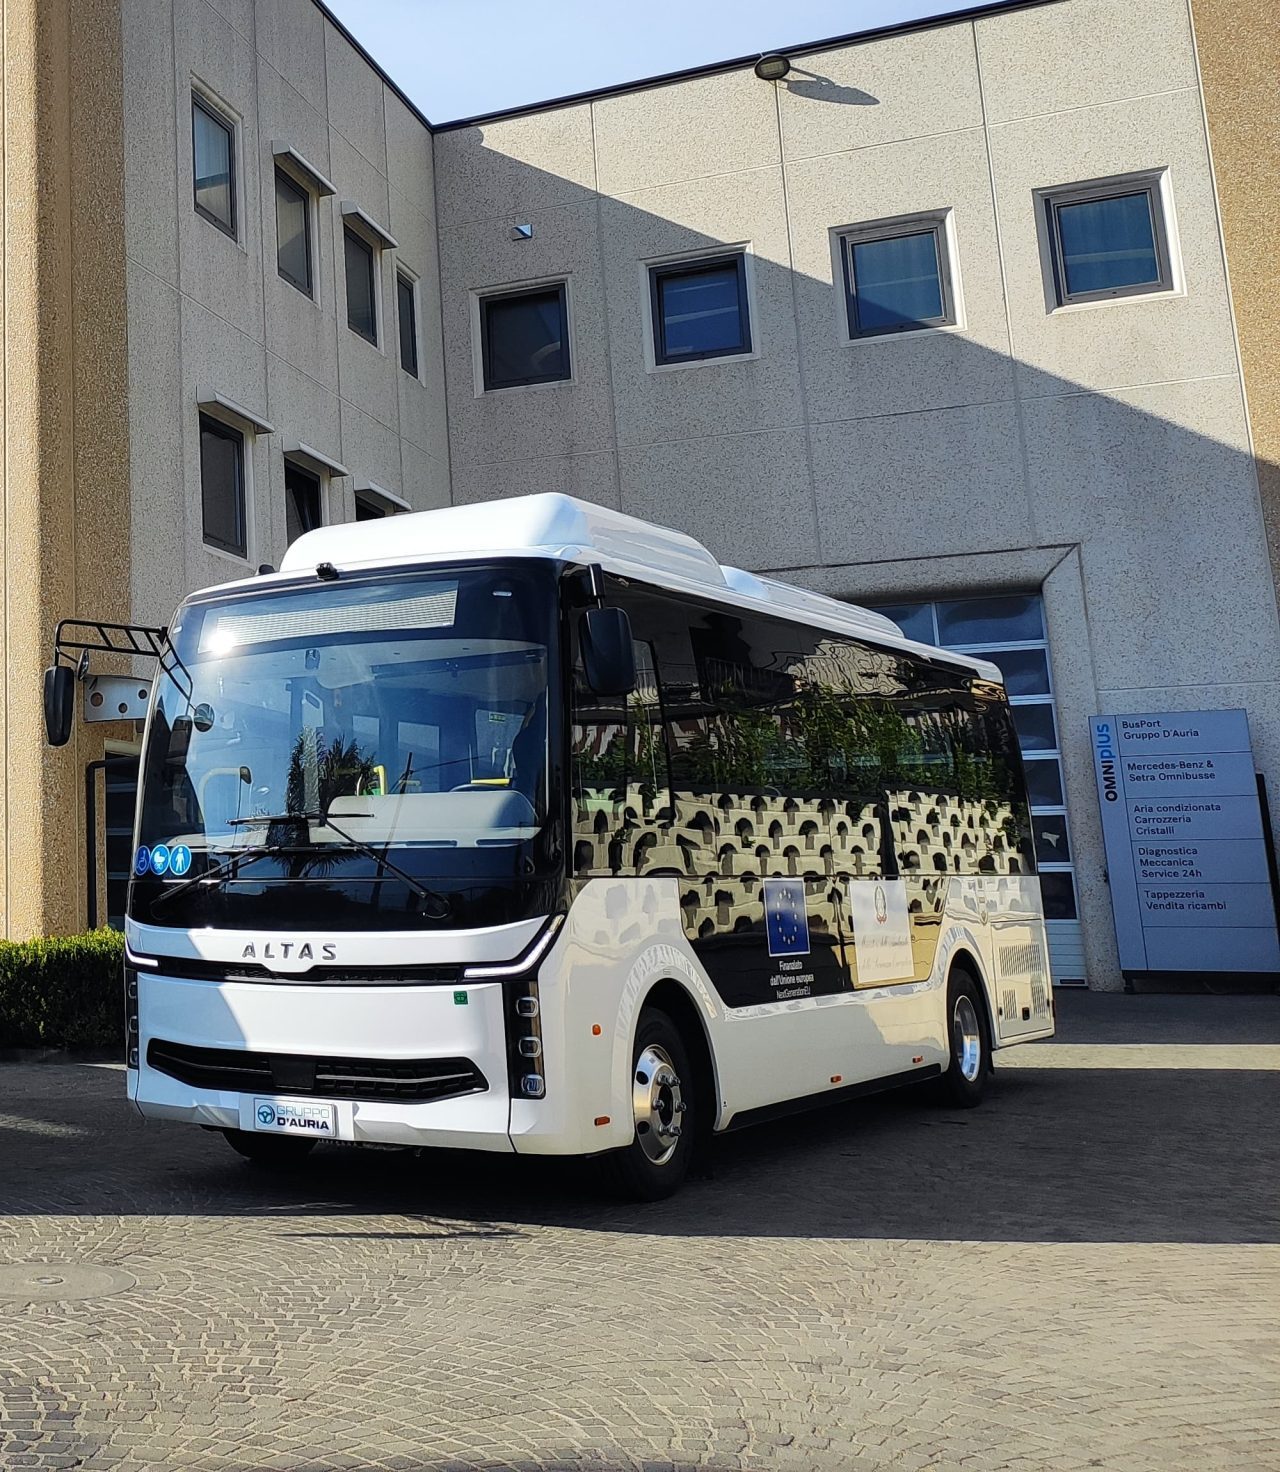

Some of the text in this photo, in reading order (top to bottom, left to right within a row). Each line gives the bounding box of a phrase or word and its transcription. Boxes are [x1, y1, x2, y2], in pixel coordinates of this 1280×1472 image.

[1121, 720, 1161, 729] BusPort
[1123, 729, 1200, 741] Gruppo D'Auria
[1096, 722, 1118, 803] OMNIplus
[1127, 760, 1214, 771] Mercedes-Benz &
[1129, 771, 1216, 782] Setra Omnibusse
[1133, 803, 1222, 813] Aria condizionata
[1134, 815, 1192, 824] Carrozzeria
[1136, 826, 1175, 836] Cristalli
[1138, 846, 1198, 858] Diagnostica
[1139, 858, 1194, 867] Meccanica
[1141, 869, 1202, 879] Service 24h
[1144, 890, 1205, 901] Tappezzeria
[1146, 901, 1227, 911] Vendita ricambi
[242, 942, 337, 960] ALTAS
[276, 1105, 330, 1119] GRUPPO
[277, 1116, 330, 1131] D'AURIA
